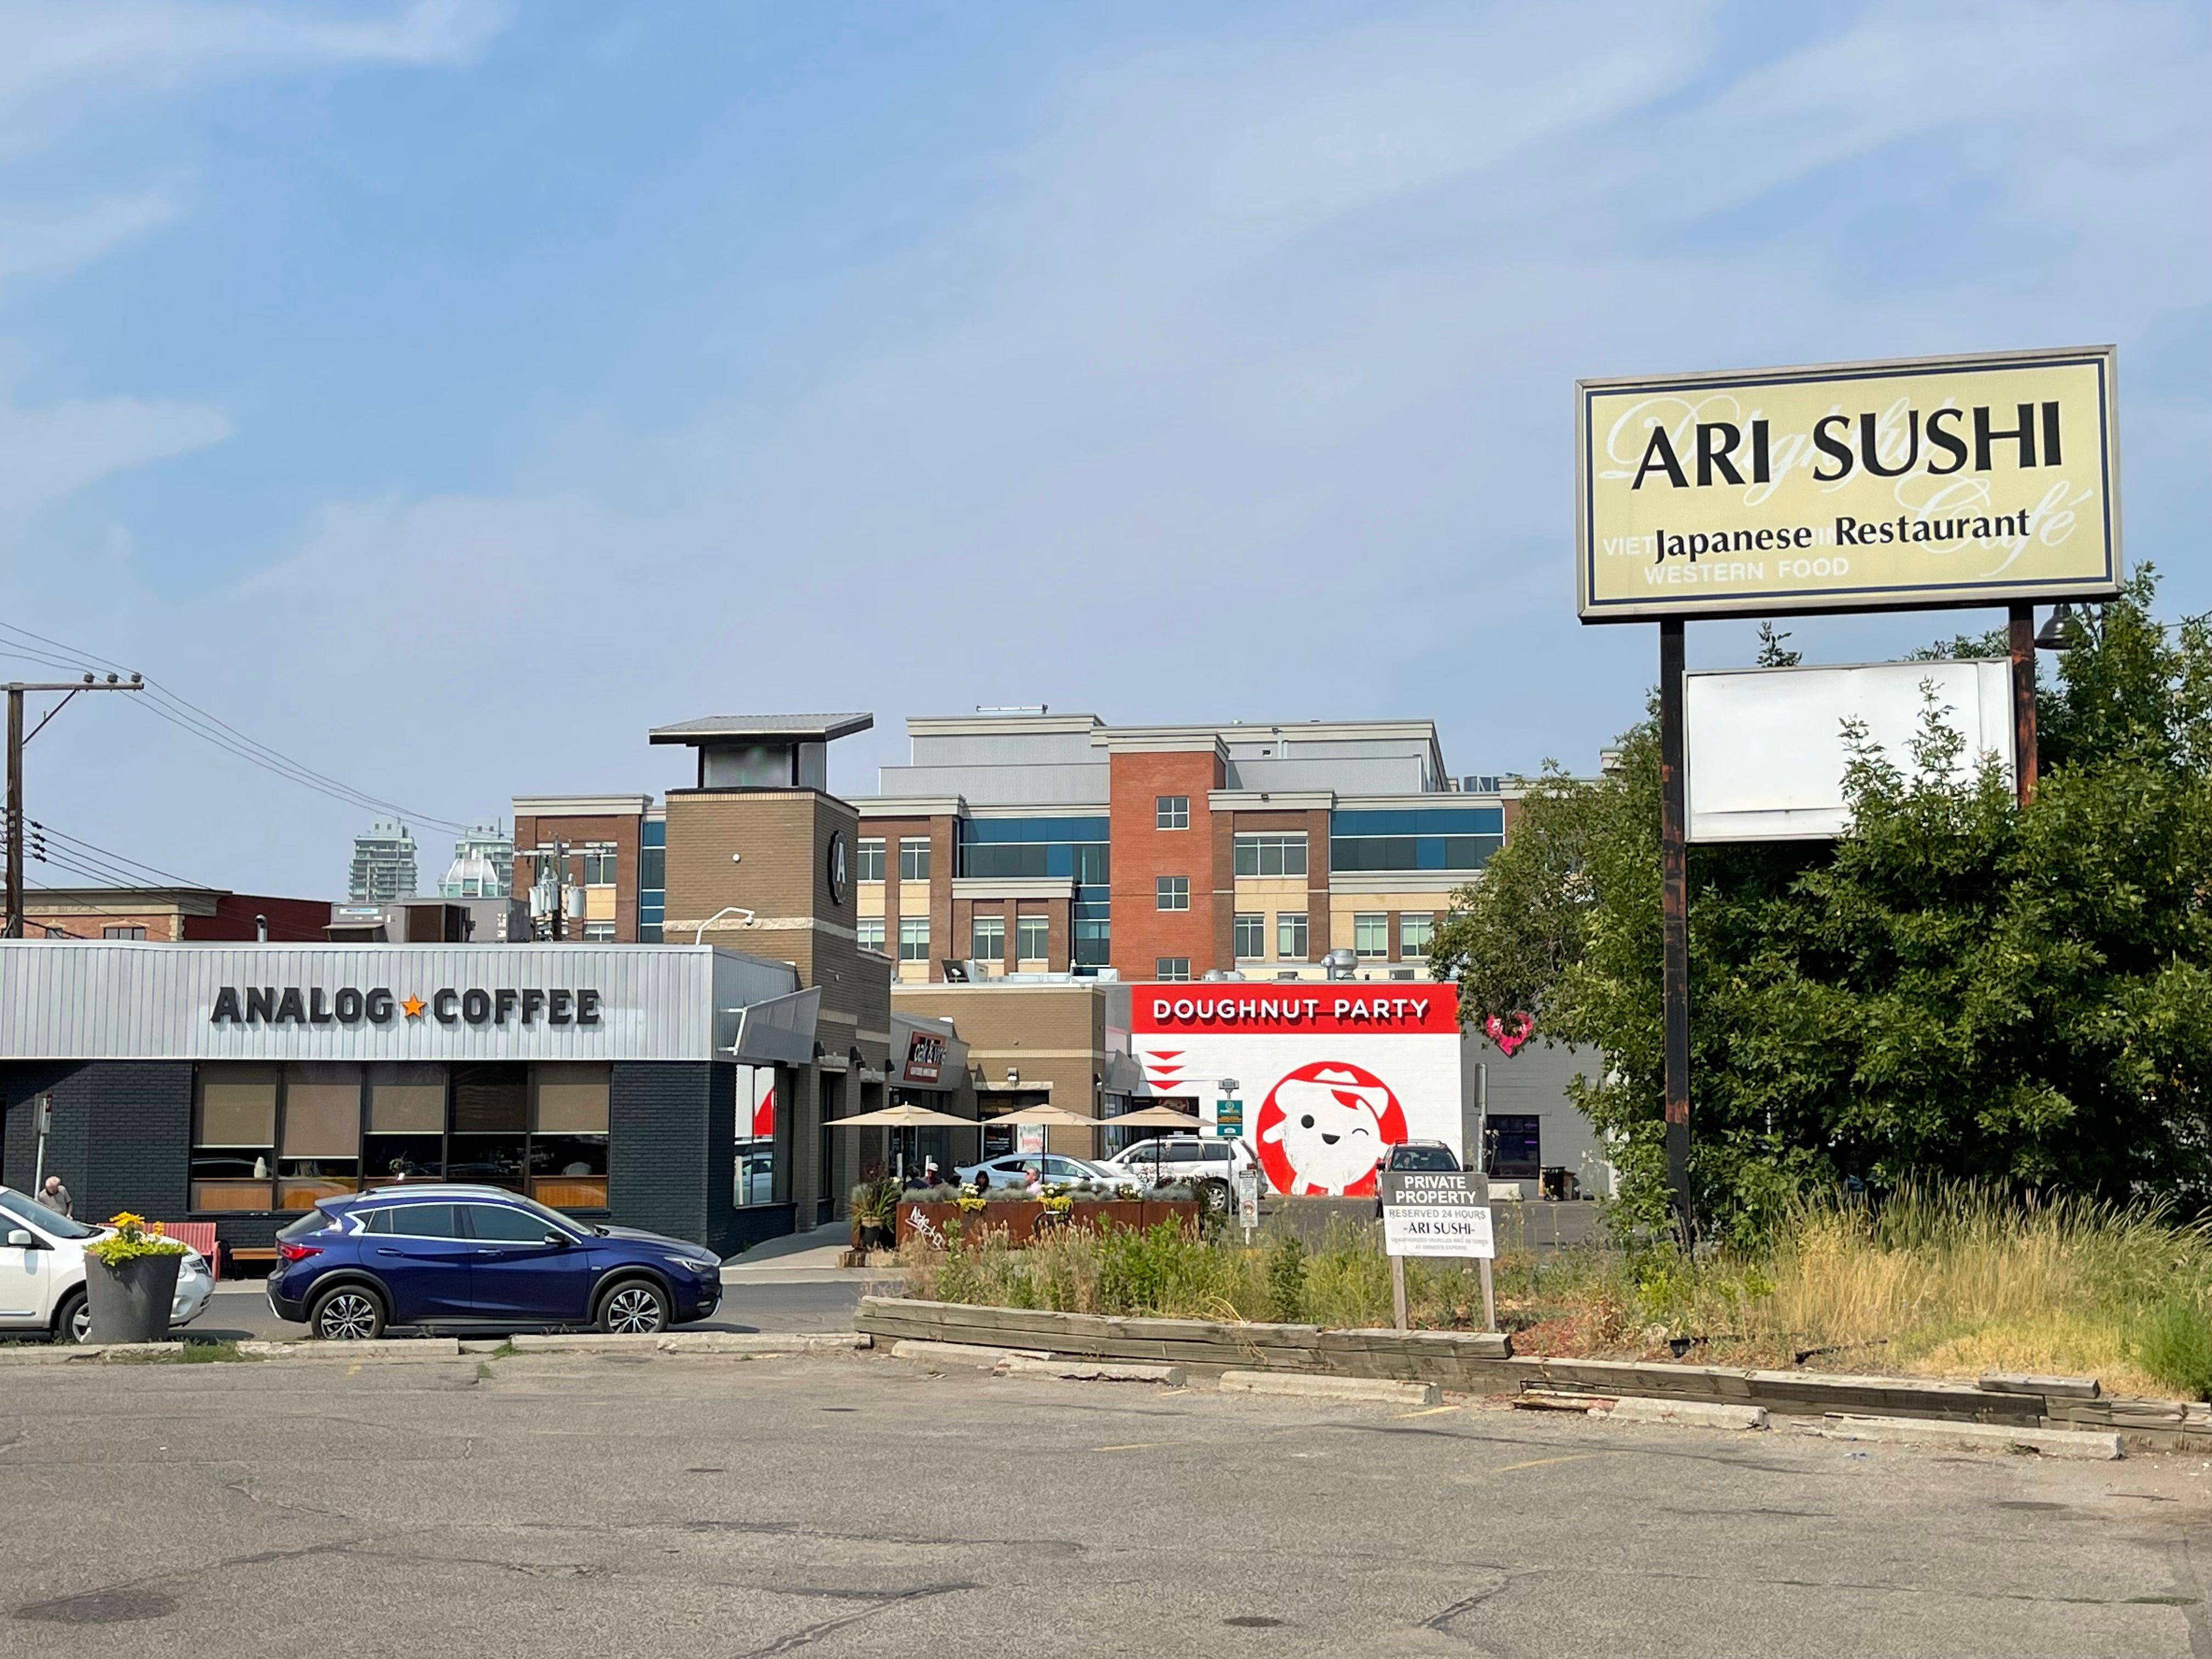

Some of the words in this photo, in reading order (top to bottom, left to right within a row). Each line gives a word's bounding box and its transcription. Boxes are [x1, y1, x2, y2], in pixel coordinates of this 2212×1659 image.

[1598, 394, 1957, 507] Dlghtful
[1631, 419, 1770, 490] ARI
[1813, 400, 2062, 481] SUSHI
[1655, 527, 1812, 565] Japanese
[1835, 508, 2030, 546] Restaurant
[1644, 562, 1764, 585] WESTERN
[1778, 557, 1849, 578] FOOD
[837, 842, 846, 884] A
[210, 986, 393, 1023] ANALOG
[434, 988, 600, 1024] COFFEE
[1153, 998, 1318, 1019] DOUGHNUT
[1334, 998, 1429, 1019] PARTY
[1395, 1190, 1477, 1204] PROPERTY
[1404, 1176, 1466, 1189] PRIVATE
[1389, 1209, 1439, 1218] RESERVED
[1455, 1210, 1486, 1220] HOURS
